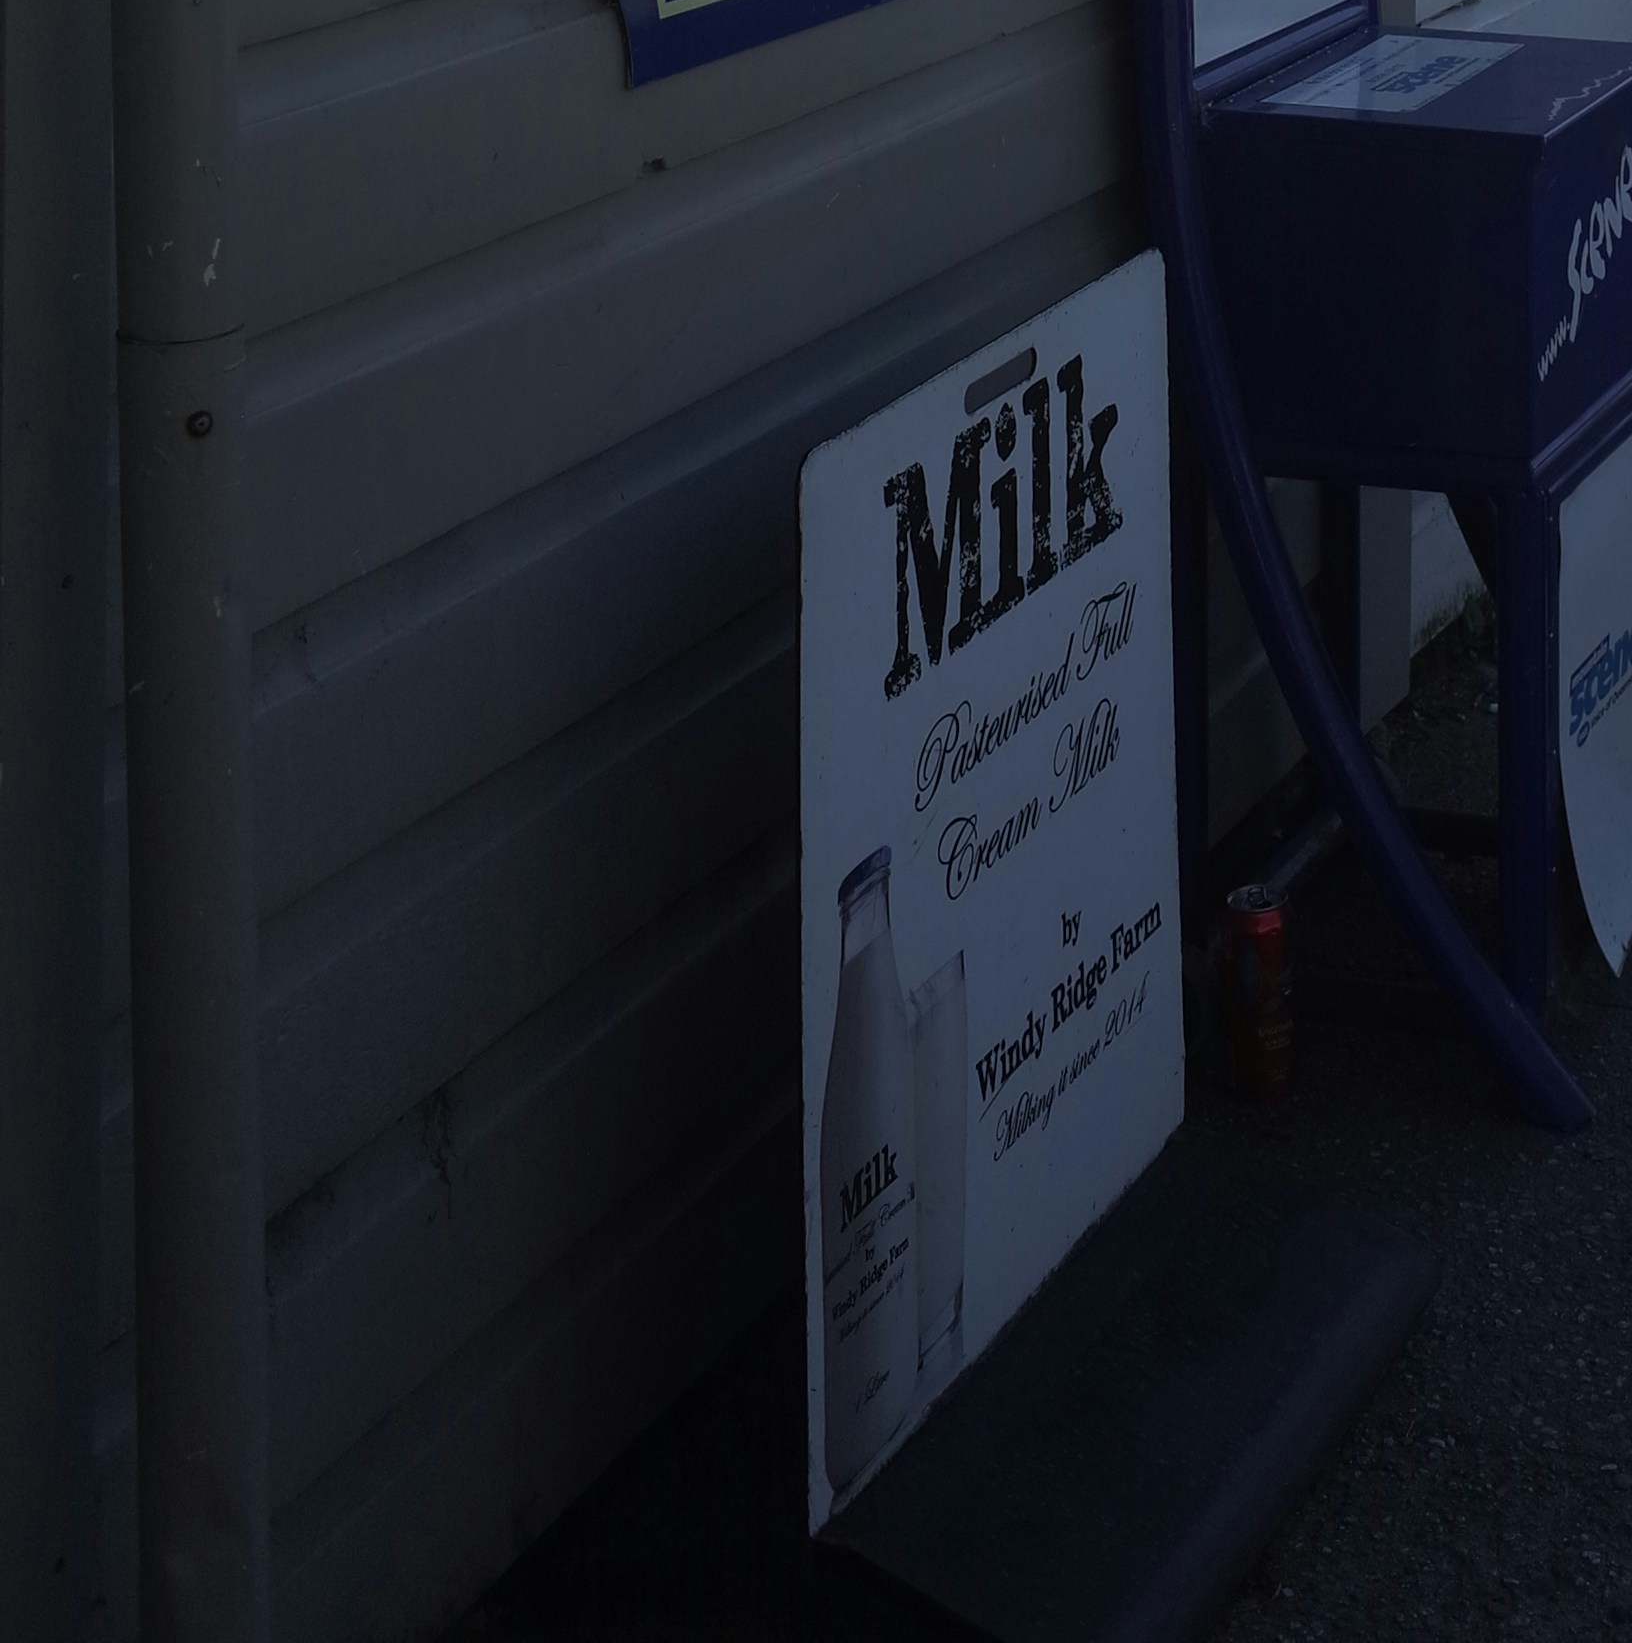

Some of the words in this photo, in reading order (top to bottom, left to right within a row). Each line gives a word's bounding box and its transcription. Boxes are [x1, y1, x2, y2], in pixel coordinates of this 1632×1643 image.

[1383, 54, 1467, 95] scene
[883, 353, 1123, 701] Milk
[915, 632, 1075, 812] Pasteurised
[1077, 582, 1137, 681] Full
[938, 796, 1042, 900] Cream
[1049, 698, 1120, 813] Milk
[975, 1011, 1047, 1102] Windy
[1051, 954, 1107, 1033] Ridge
[1110, 902, 1162, 975] Farm
[1061, 910, 1082, 948] by
[993, 1082, 1055, 1162] Milking
[1058, 1064, 1069, 1096] it
[1069, 1037, 1101, 1084] since
[1103, 970, 1150, 1051] 2014
[832, 1286, 858, 1322] Windy
[859, 1258, 888, 1295] Ridge
[889, 1237, 909, 1266] Farm
[840, 1143, 899, 1233] Milk
